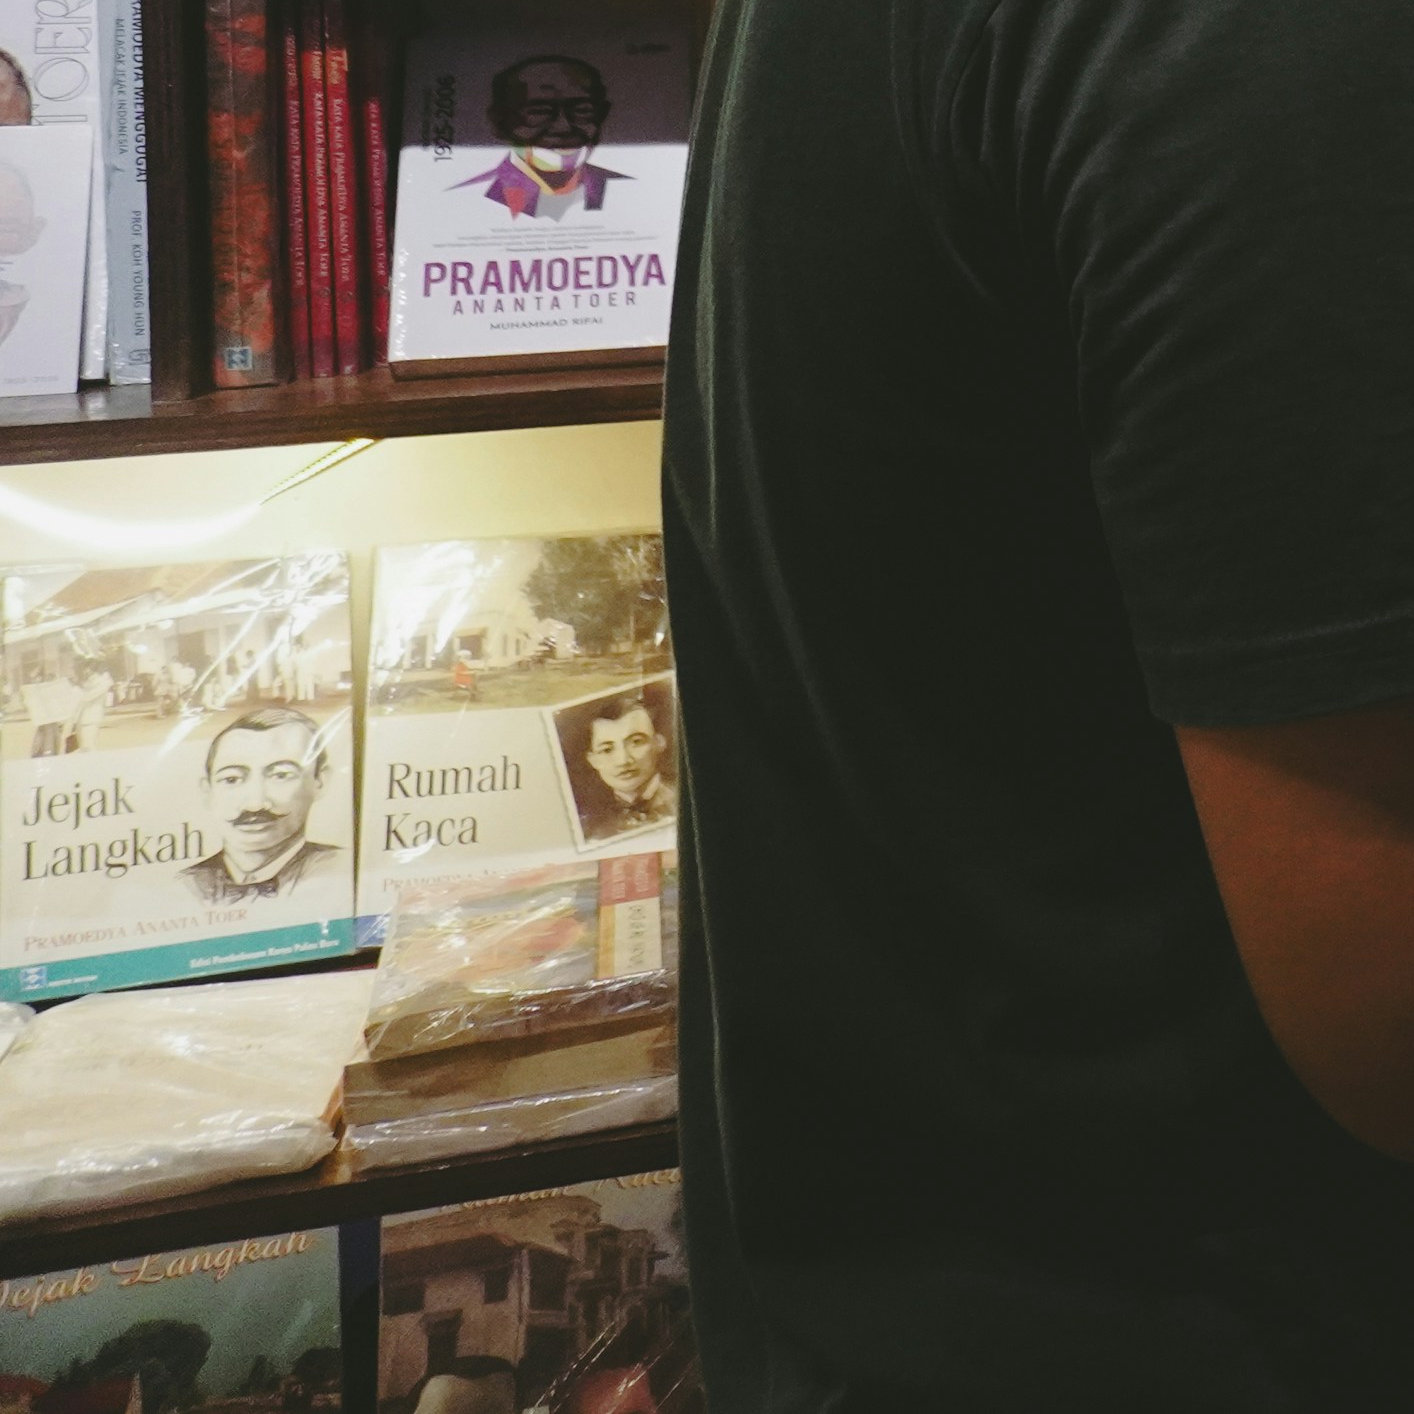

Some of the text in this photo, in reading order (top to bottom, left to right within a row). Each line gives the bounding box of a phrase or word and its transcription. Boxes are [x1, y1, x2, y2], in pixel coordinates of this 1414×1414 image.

[423, 253, 666, 298] PRAMOEDYA
[453, 292, 636, 315] ANANTA TOER
[490, 319, 568, 330] MUHAMMAD
[386, 755, 522, 800] Rumah
[22, 778, 135, 830] Jejak
[23, 822, 207, 879] Langkah
[383, 812, 479, 852] Kaca
